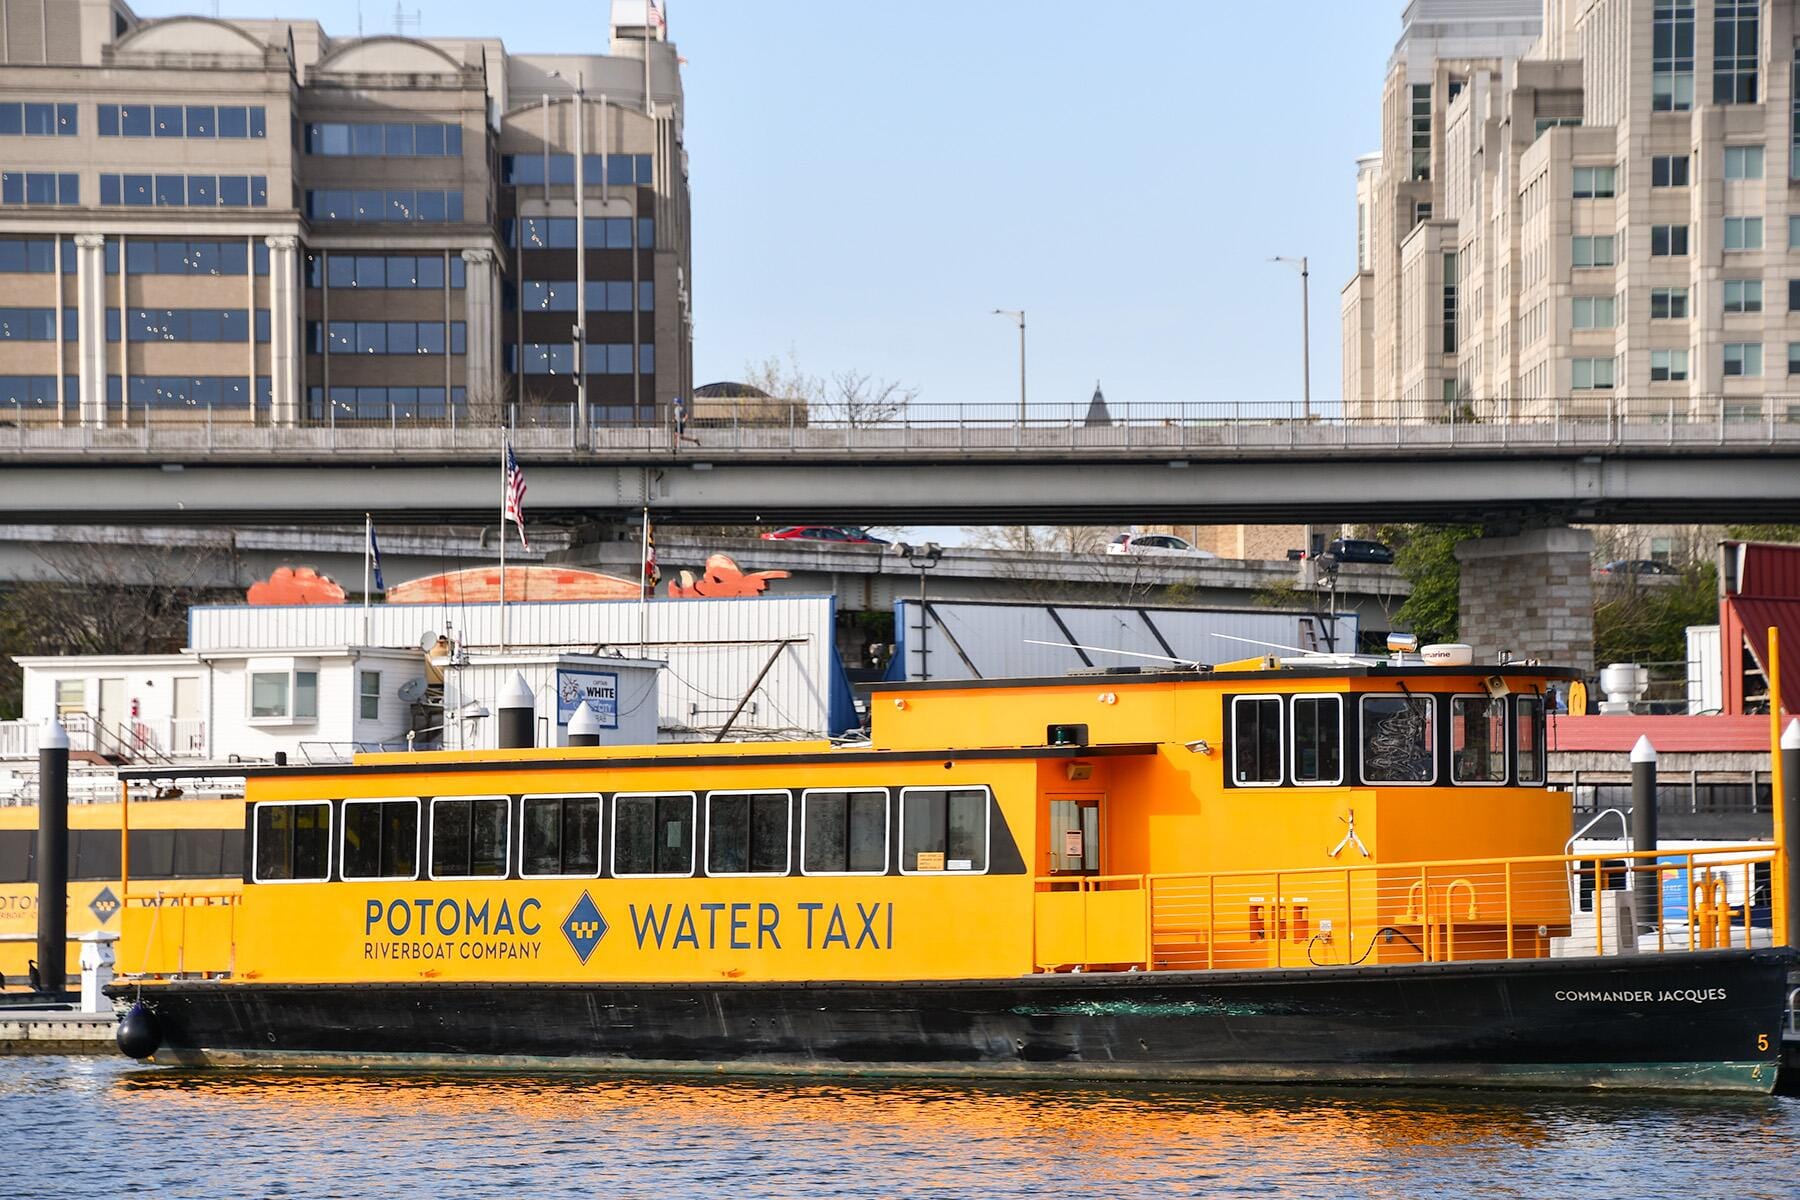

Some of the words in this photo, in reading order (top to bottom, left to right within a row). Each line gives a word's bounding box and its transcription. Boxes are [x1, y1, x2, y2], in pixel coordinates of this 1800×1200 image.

[586, 686, 615, 698] WHITE
[365, 898, 542, 936] POTOMAC
[629, 903, 782, 950] WATER
[797, 902, 893, 950] TAXI
[364, 942, 455, 960] RIVERBOAT
[459, 942, 542, 959] COMPANY
[1554, 990, 1654, 1002] COMMANDER
[1657, 988, 1727, 1004] JACQUES
[1757, 1033, 1769, 1051] 5
